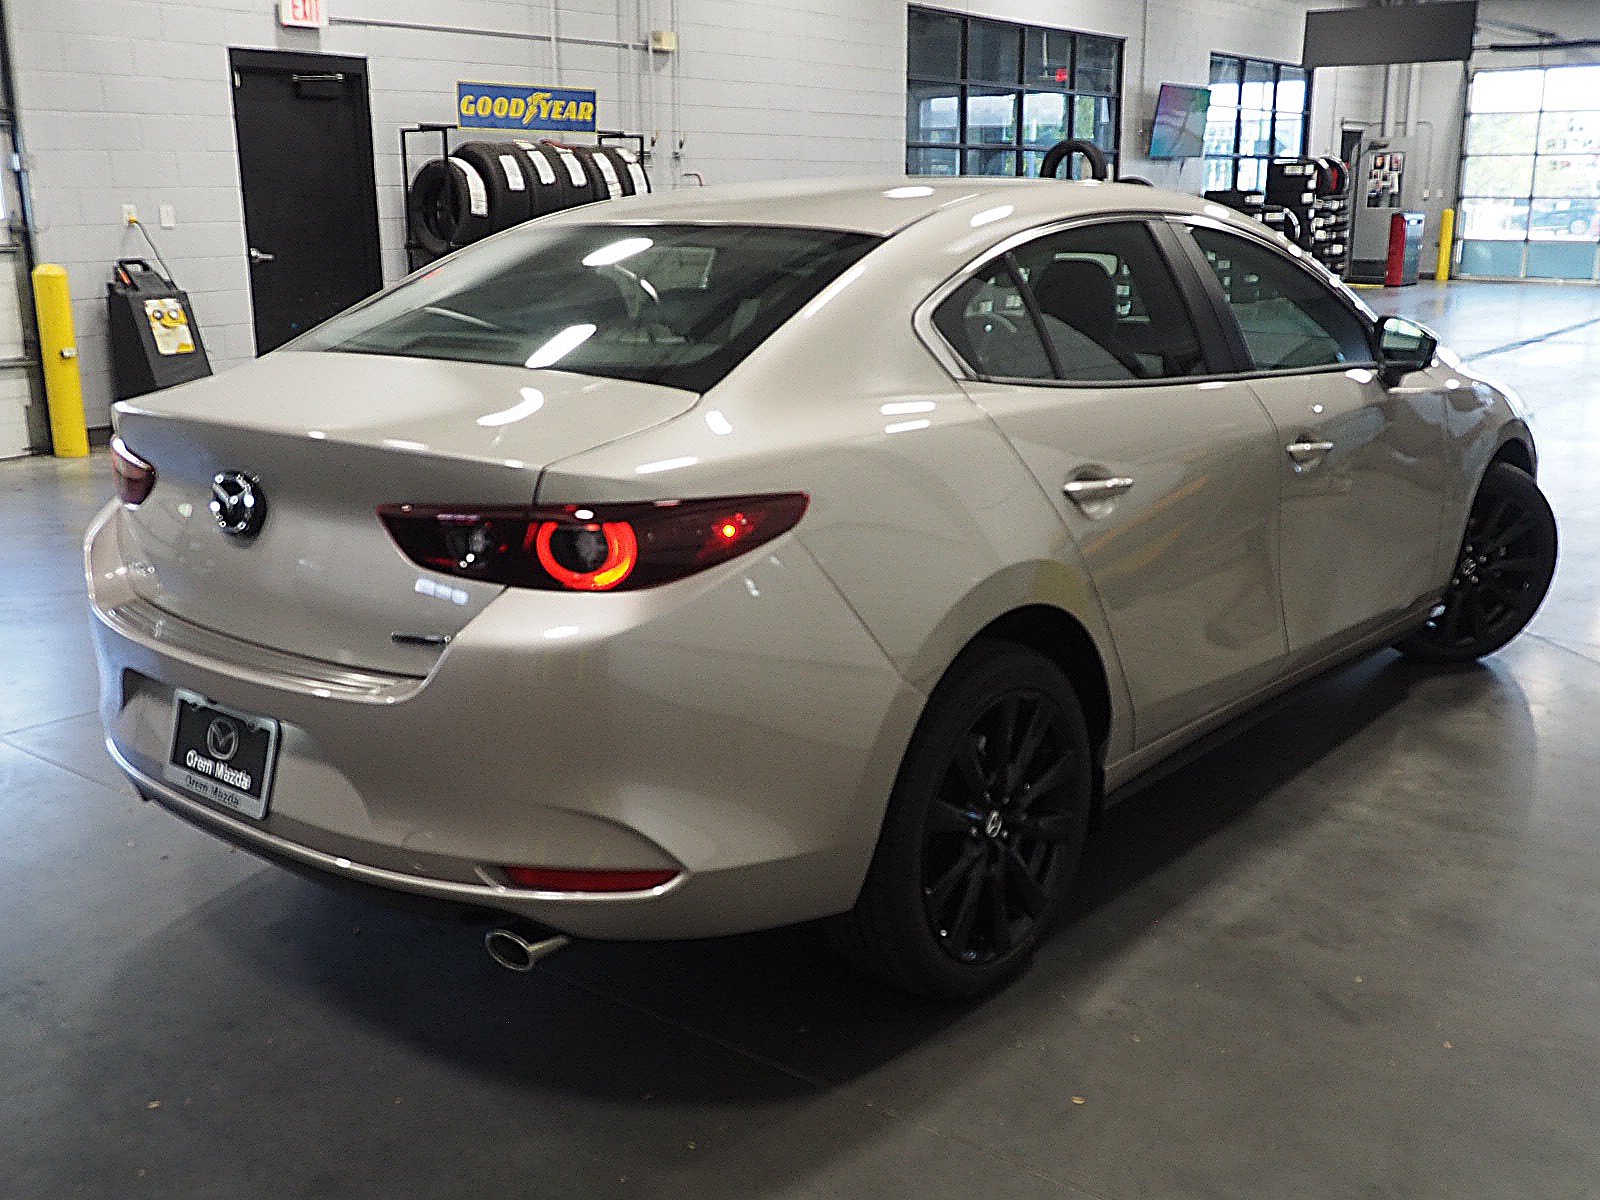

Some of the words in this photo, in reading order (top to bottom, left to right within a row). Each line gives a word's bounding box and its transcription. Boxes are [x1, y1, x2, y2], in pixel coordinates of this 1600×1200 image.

[460, 93, 595, 122] GOODYEAR
[186, 749, 213, 775] Orem
[214, 760, 252, 790] Mazda
[186, 774, 208, 793] Orem
[211, 785, 240, 807] Mazda
